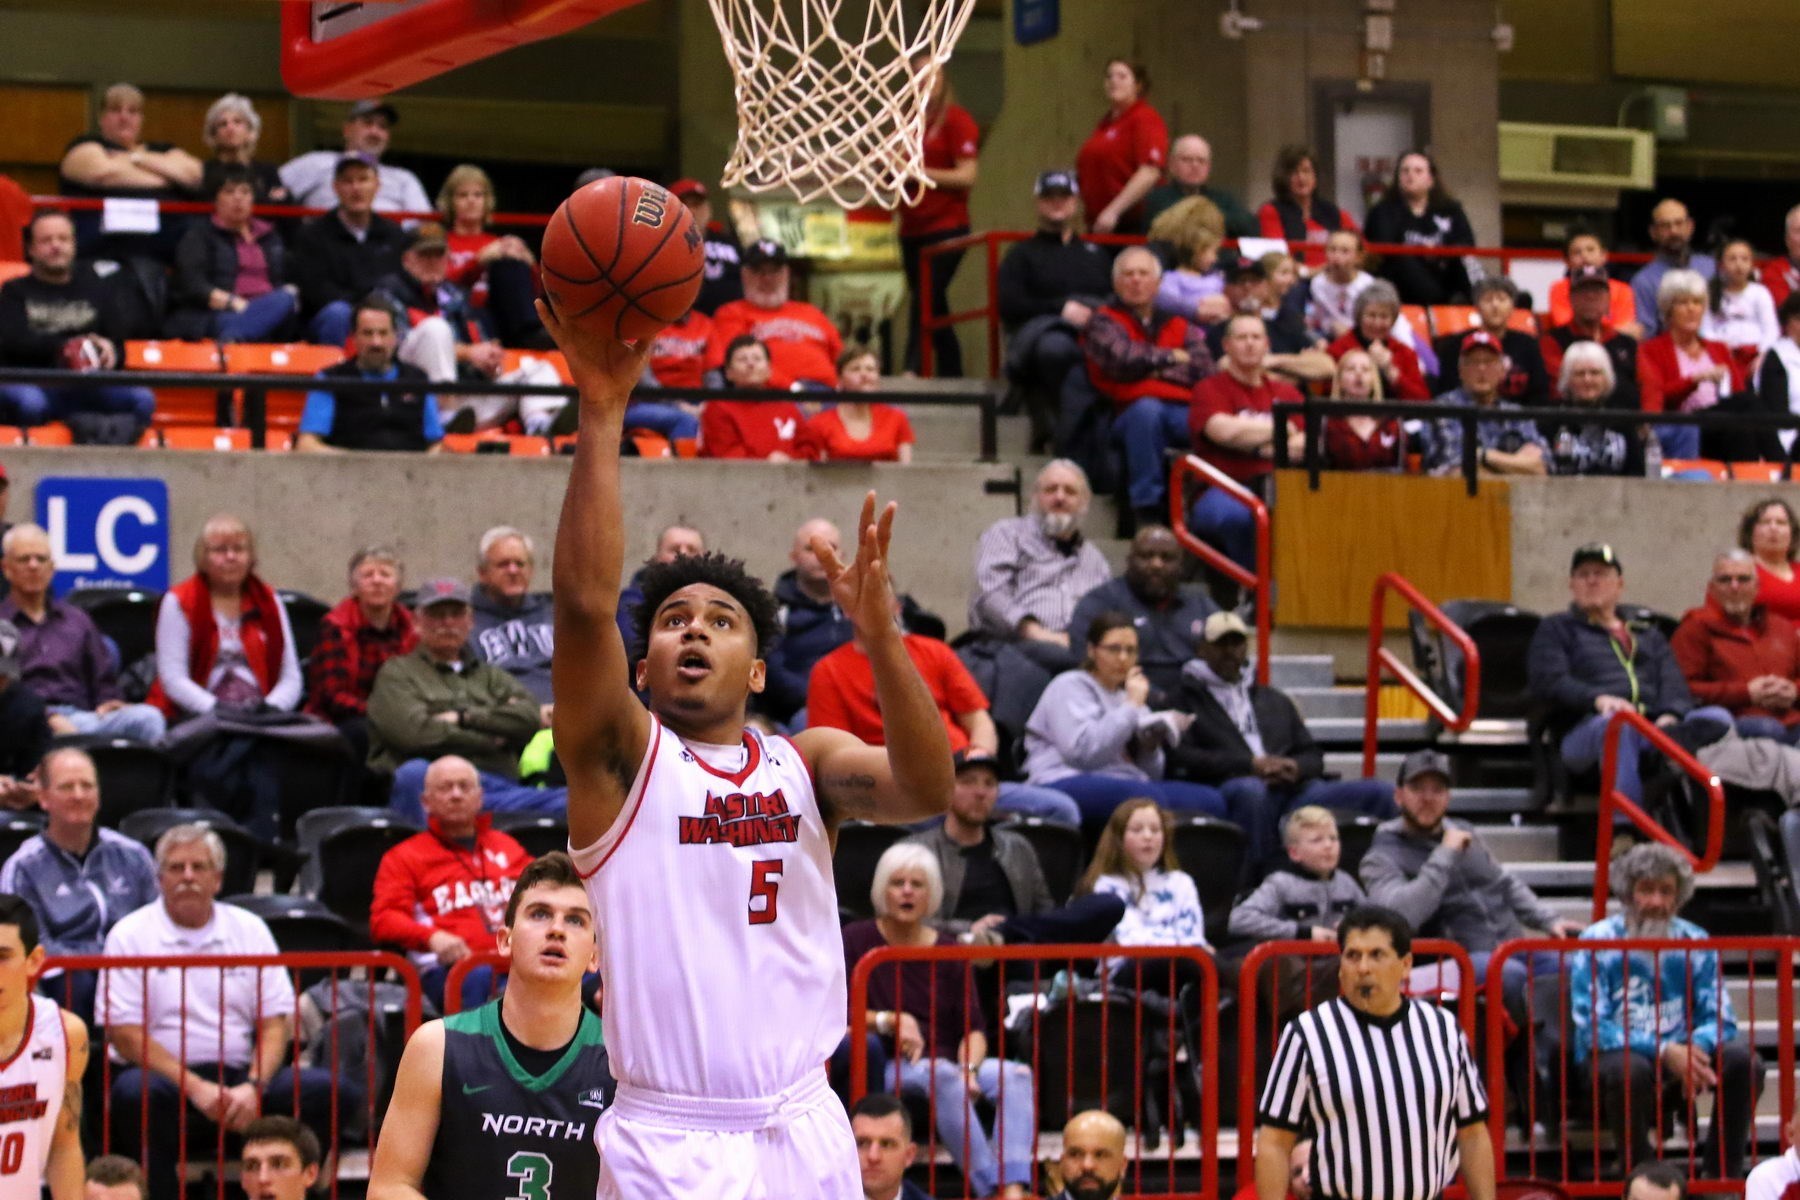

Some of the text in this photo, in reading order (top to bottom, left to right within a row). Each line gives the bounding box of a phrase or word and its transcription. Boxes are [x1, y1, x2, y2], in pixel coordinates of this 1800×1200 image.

[47, 495, 159, 575] LC
[748, 858, 784, 926] 5
[481, 1112, 586, 1142] NORTH
[0, 1131, 25, 1177] 0
[504, 1150, 554, 1200] 3
